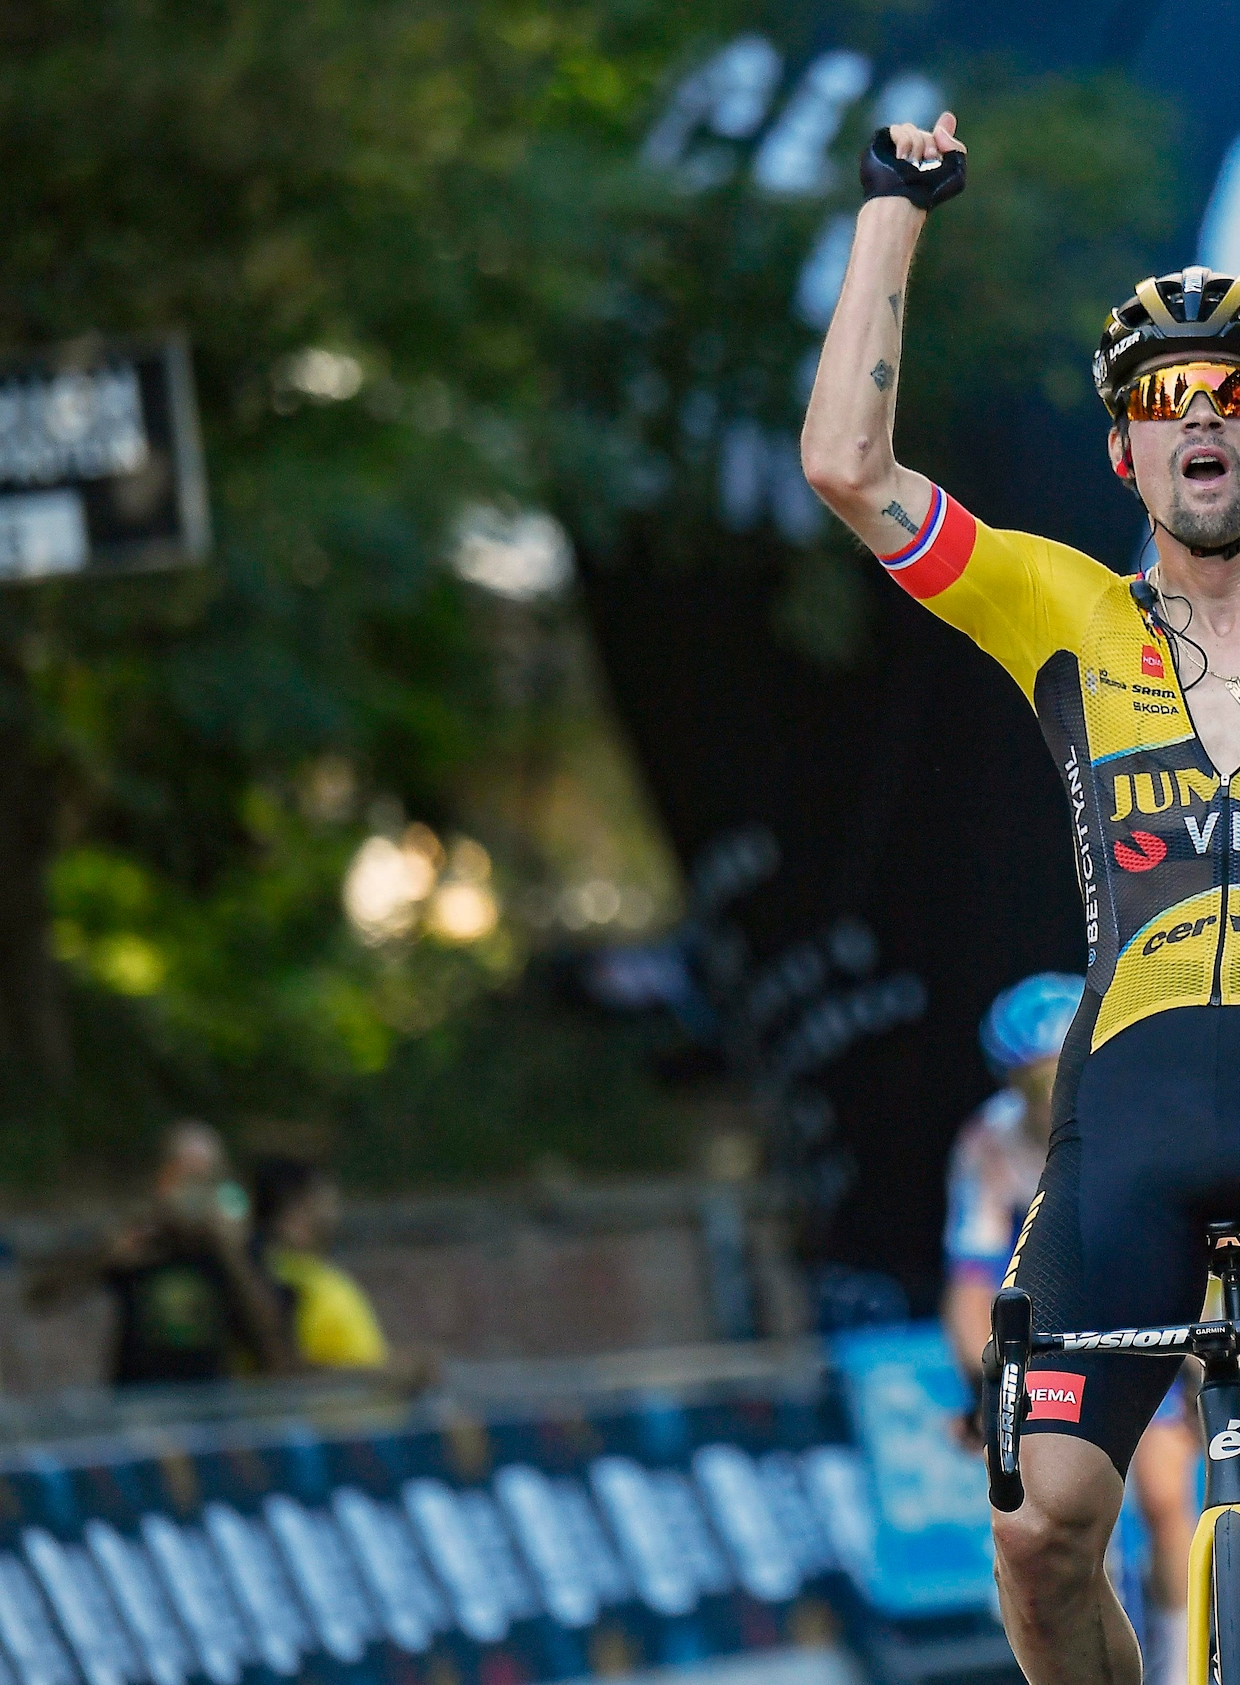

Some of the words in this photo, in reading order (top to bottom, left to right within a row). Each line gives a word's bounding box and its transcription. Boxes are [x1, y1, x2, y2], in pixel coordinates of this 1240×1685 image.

[1109, 331, 1141, 361] LAZER
[1131, 684, 1177, 700] SRAM
[1064, 745, 1099, 944] BETCITY.NL
[1195, 1326, 1226, 1335] GARMIN
[1002, 1362, 1020, 1453] SRAM
